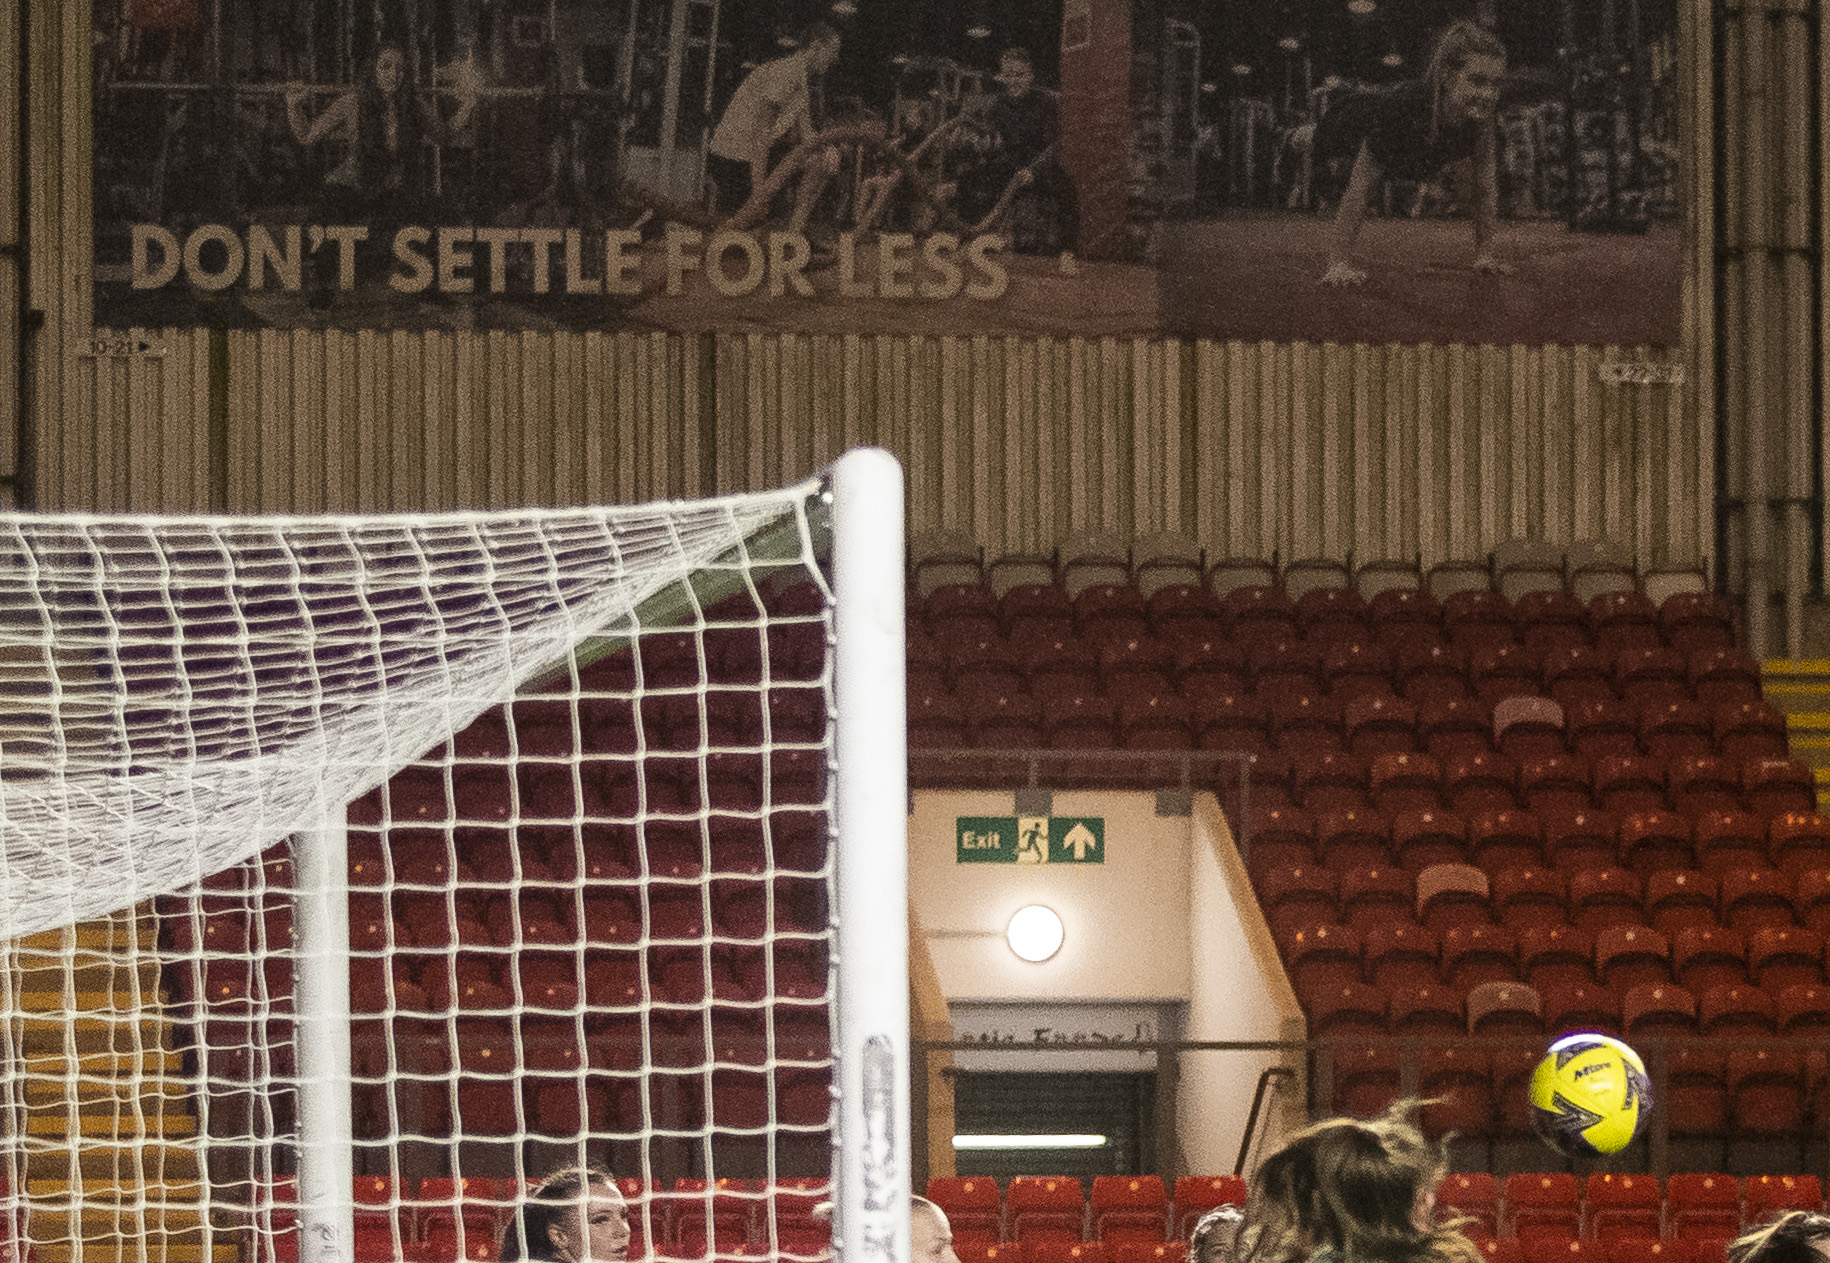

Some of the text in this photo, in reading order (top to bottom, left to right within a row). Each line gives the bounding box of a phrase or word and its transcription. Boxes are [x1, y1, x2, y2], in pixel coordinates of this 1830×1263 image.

[131, 224, 1010, 299] DON'T SETTLE FOR LESS
[962, 831, 1000, 849] Exit
